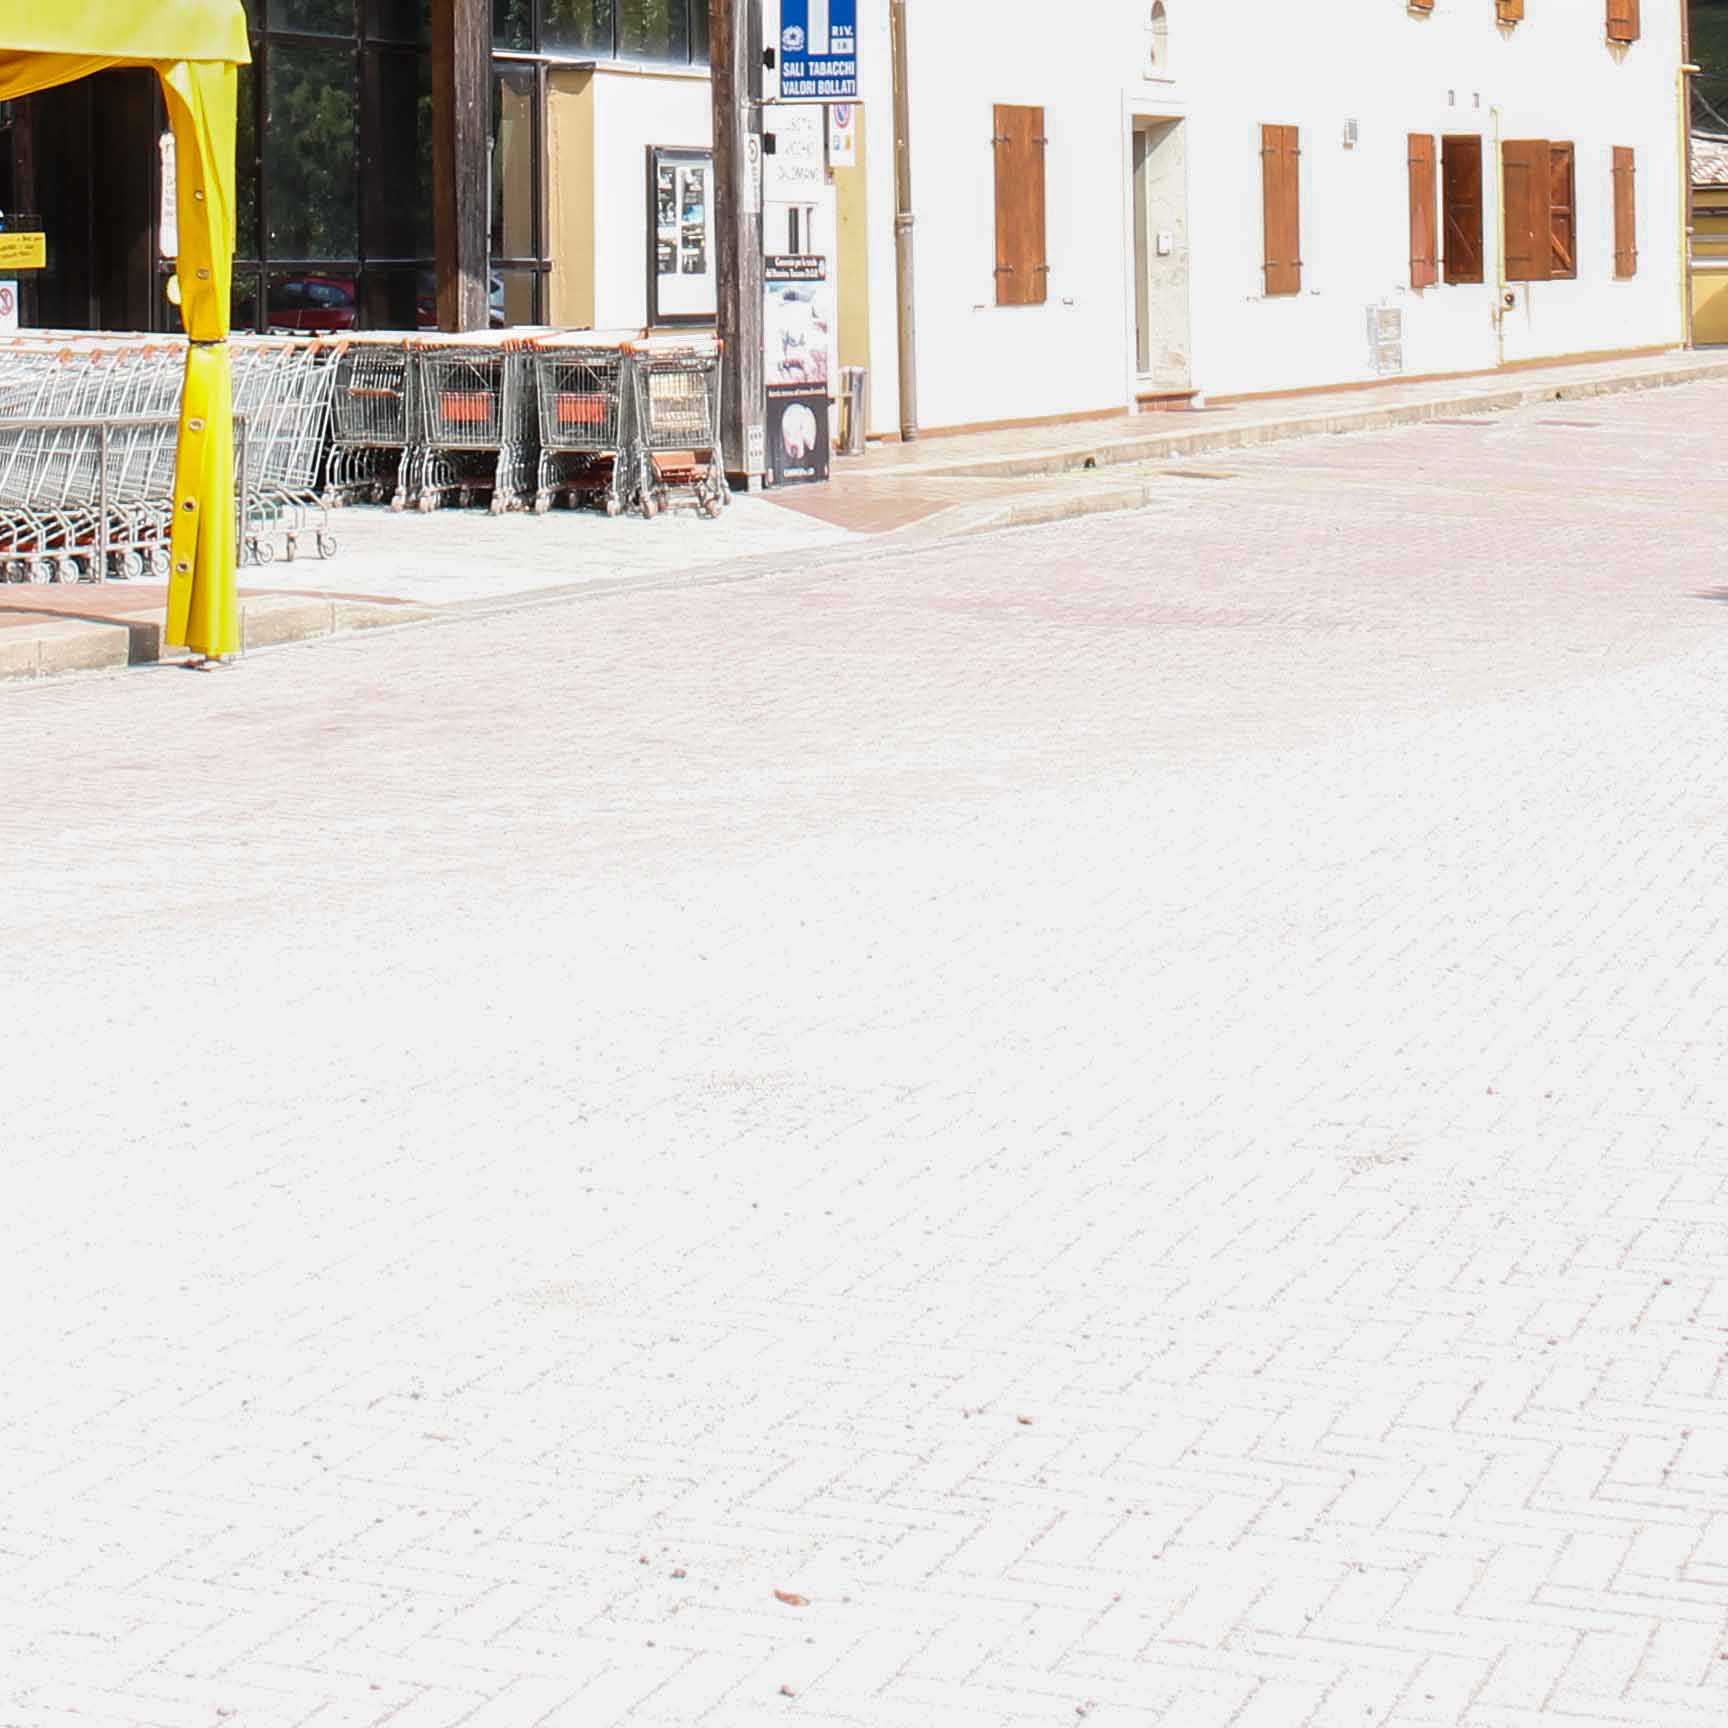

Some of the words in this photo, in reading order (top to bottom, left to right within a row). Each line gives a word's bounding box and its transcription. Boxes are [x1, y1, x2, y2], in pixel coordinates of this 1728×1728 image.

[831, 25, 854, 37] RIV.
[783, 61, 805, 77] SALI
[808, 60, 855, 76] TABACCHI
[782, 80, 816, 95] VALORI
[818, 80, 856, 95] BOLLATI
